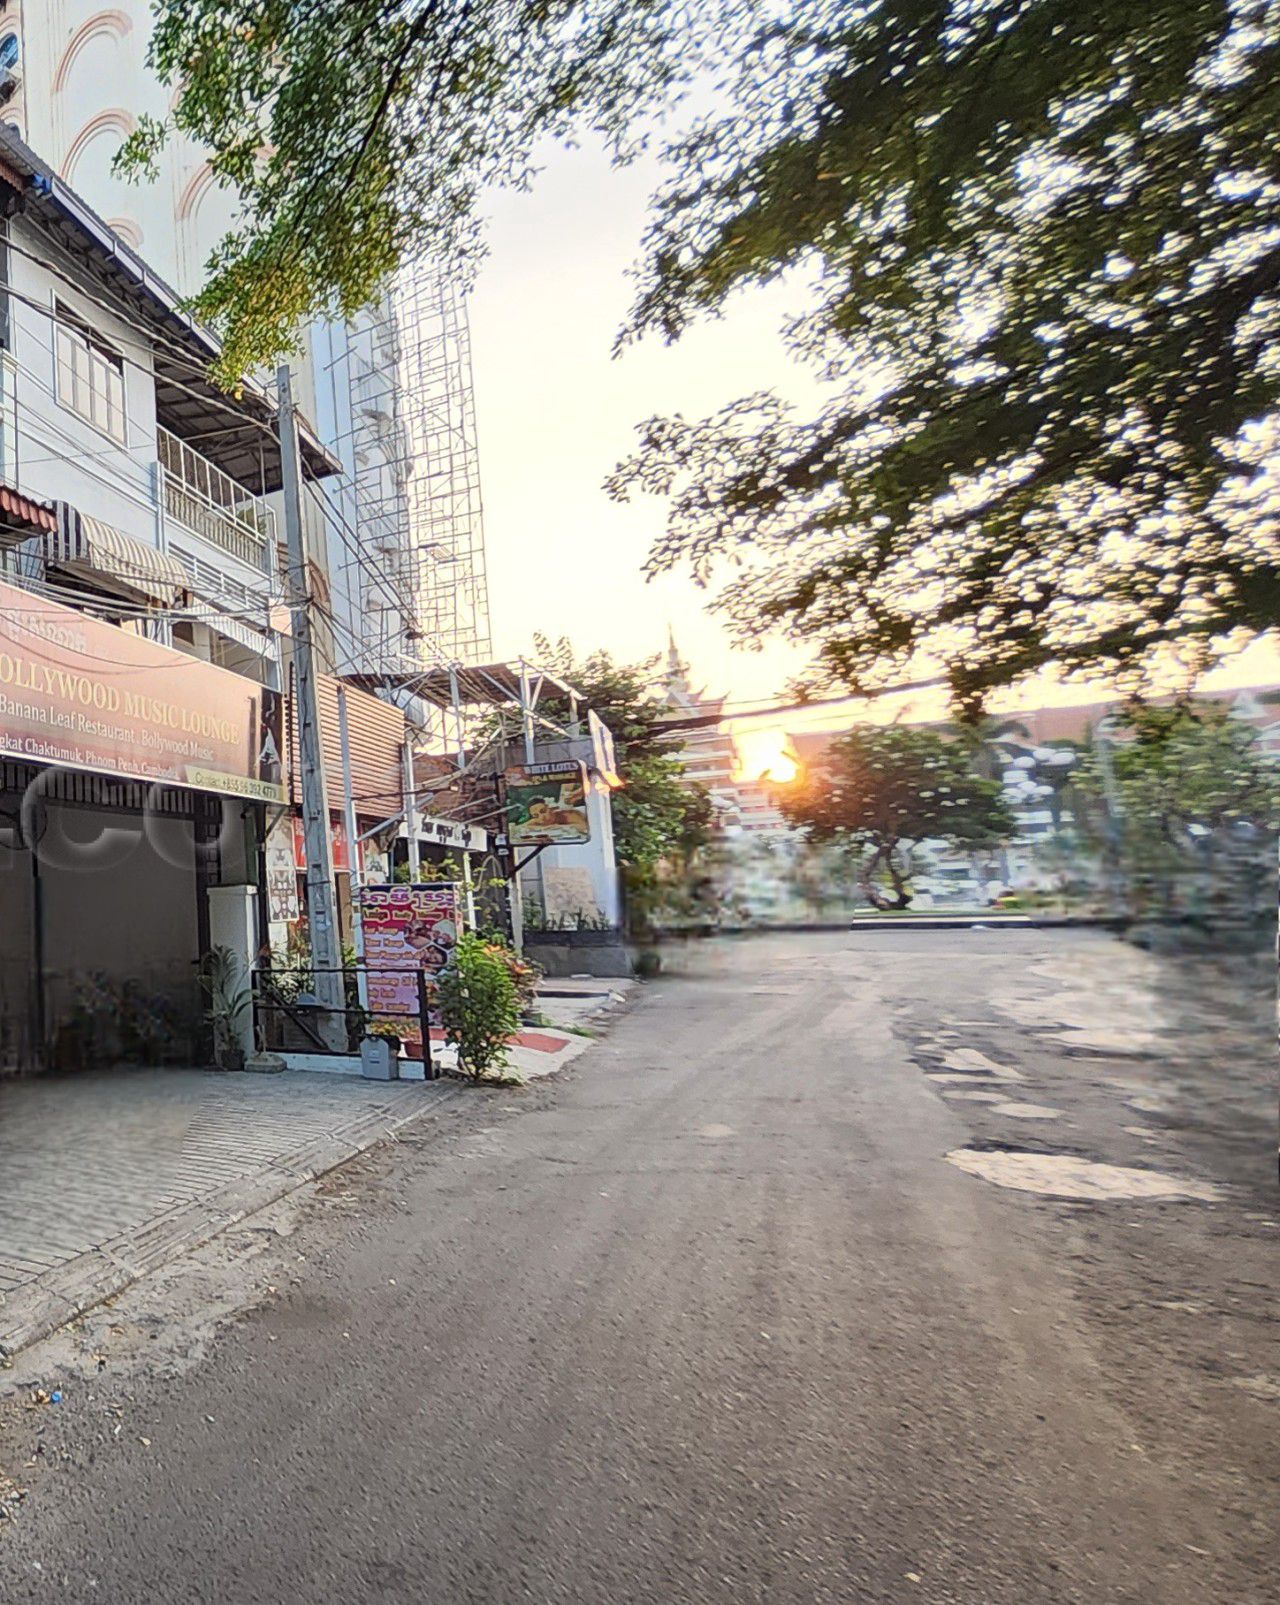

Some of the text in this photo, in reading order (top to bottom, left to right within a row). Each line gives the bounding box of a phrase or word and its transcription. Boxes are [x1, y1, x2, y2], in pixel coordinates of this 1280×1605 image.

[50, 706, 76, 730] Leaf
[78, 713, 135, 744] Restaurant
[141, 730, 189, 754] Bollywood
[190, 741, 214, 761] Music
[124, 691, 179, 728] MUSIC
[182, 709, 240, 745] LOUNGE
[25, 738, 84, 763] Chaktumuk,
[86, 750, 116, 769] Phnom
